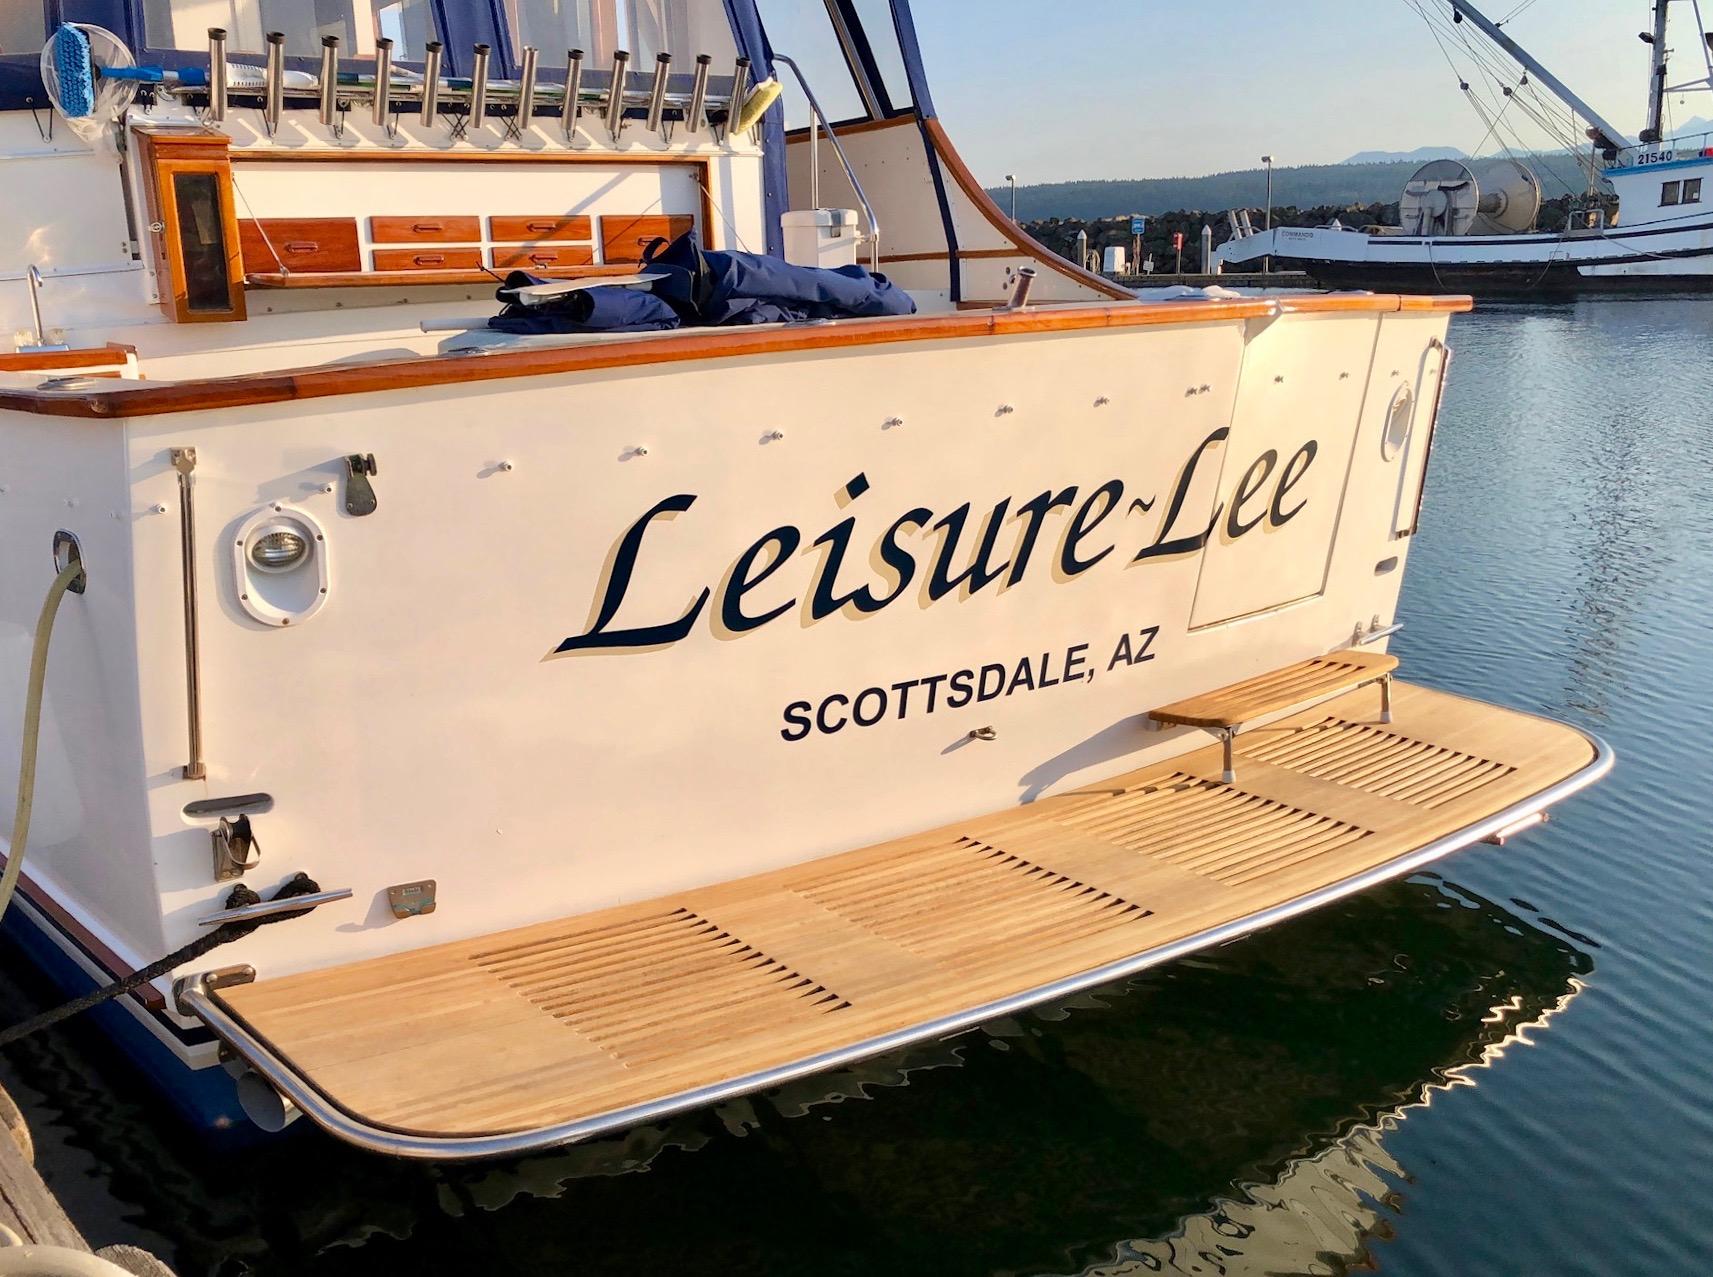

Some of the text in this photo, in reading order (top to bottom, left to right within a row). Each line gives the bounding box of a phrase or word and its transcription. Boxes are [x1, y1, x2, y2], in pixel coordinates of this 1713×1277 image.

[1638, 150, 1673, 165] 21540
[781, 626, 1160, 742] SCOTTSDALE, AZ
